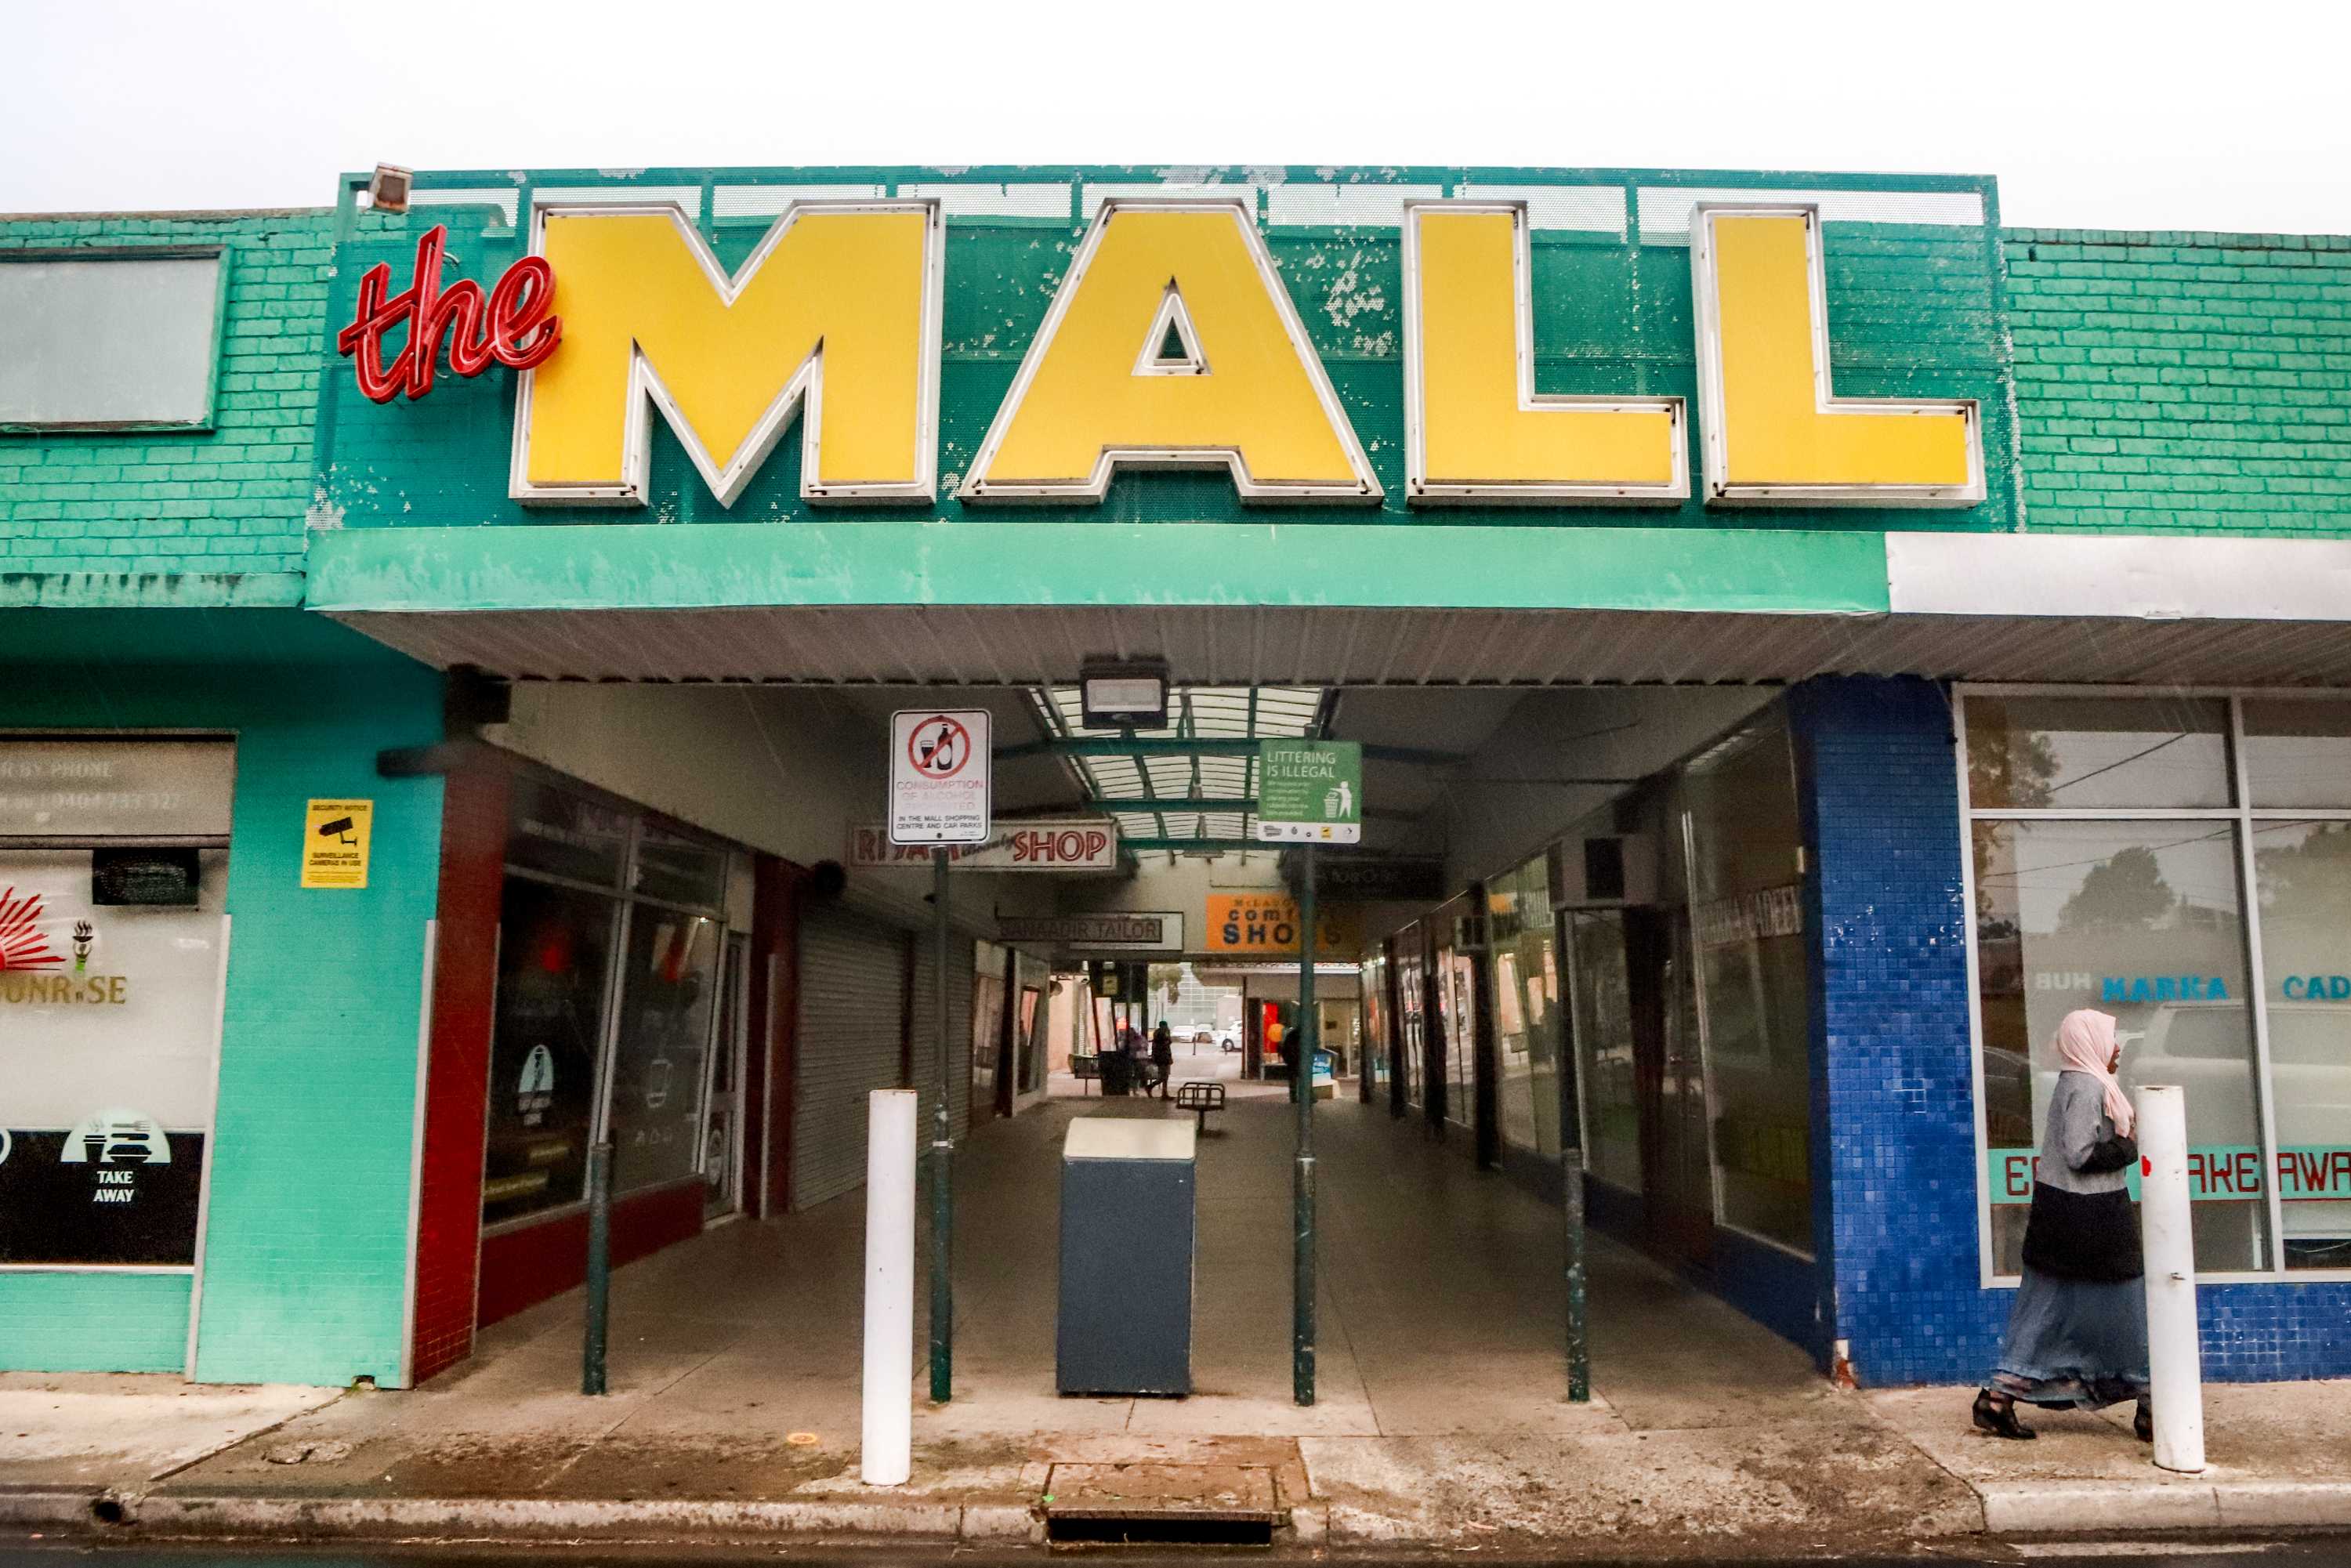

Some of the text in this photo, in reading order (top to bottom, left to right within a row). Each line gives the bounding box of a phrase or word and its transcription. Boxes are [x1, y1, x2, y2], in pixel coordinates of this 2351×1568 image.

[338, 196, 1984, 509] the MALL
[1267, 751, 1336, 765] LITTERING
[51, 761, 112, 777] PHONE
[1267, 766, 1335, 777] IS ILLEGAL
[896, 780, 984, 790] CONSUMPTION
[902, 791, 976, 800] OF ALCOHOL
[1013, 830, 1107, 861] SHOP
[1096, 920, 1157, 938] TAILOR
[1223, 923, 1342, 945] SHOS
[96, 1171, 133, 1184] TAKE
[2189, 1153, 2259, 1194] AKE
[92, 1189, 135, 1203] AWAY
